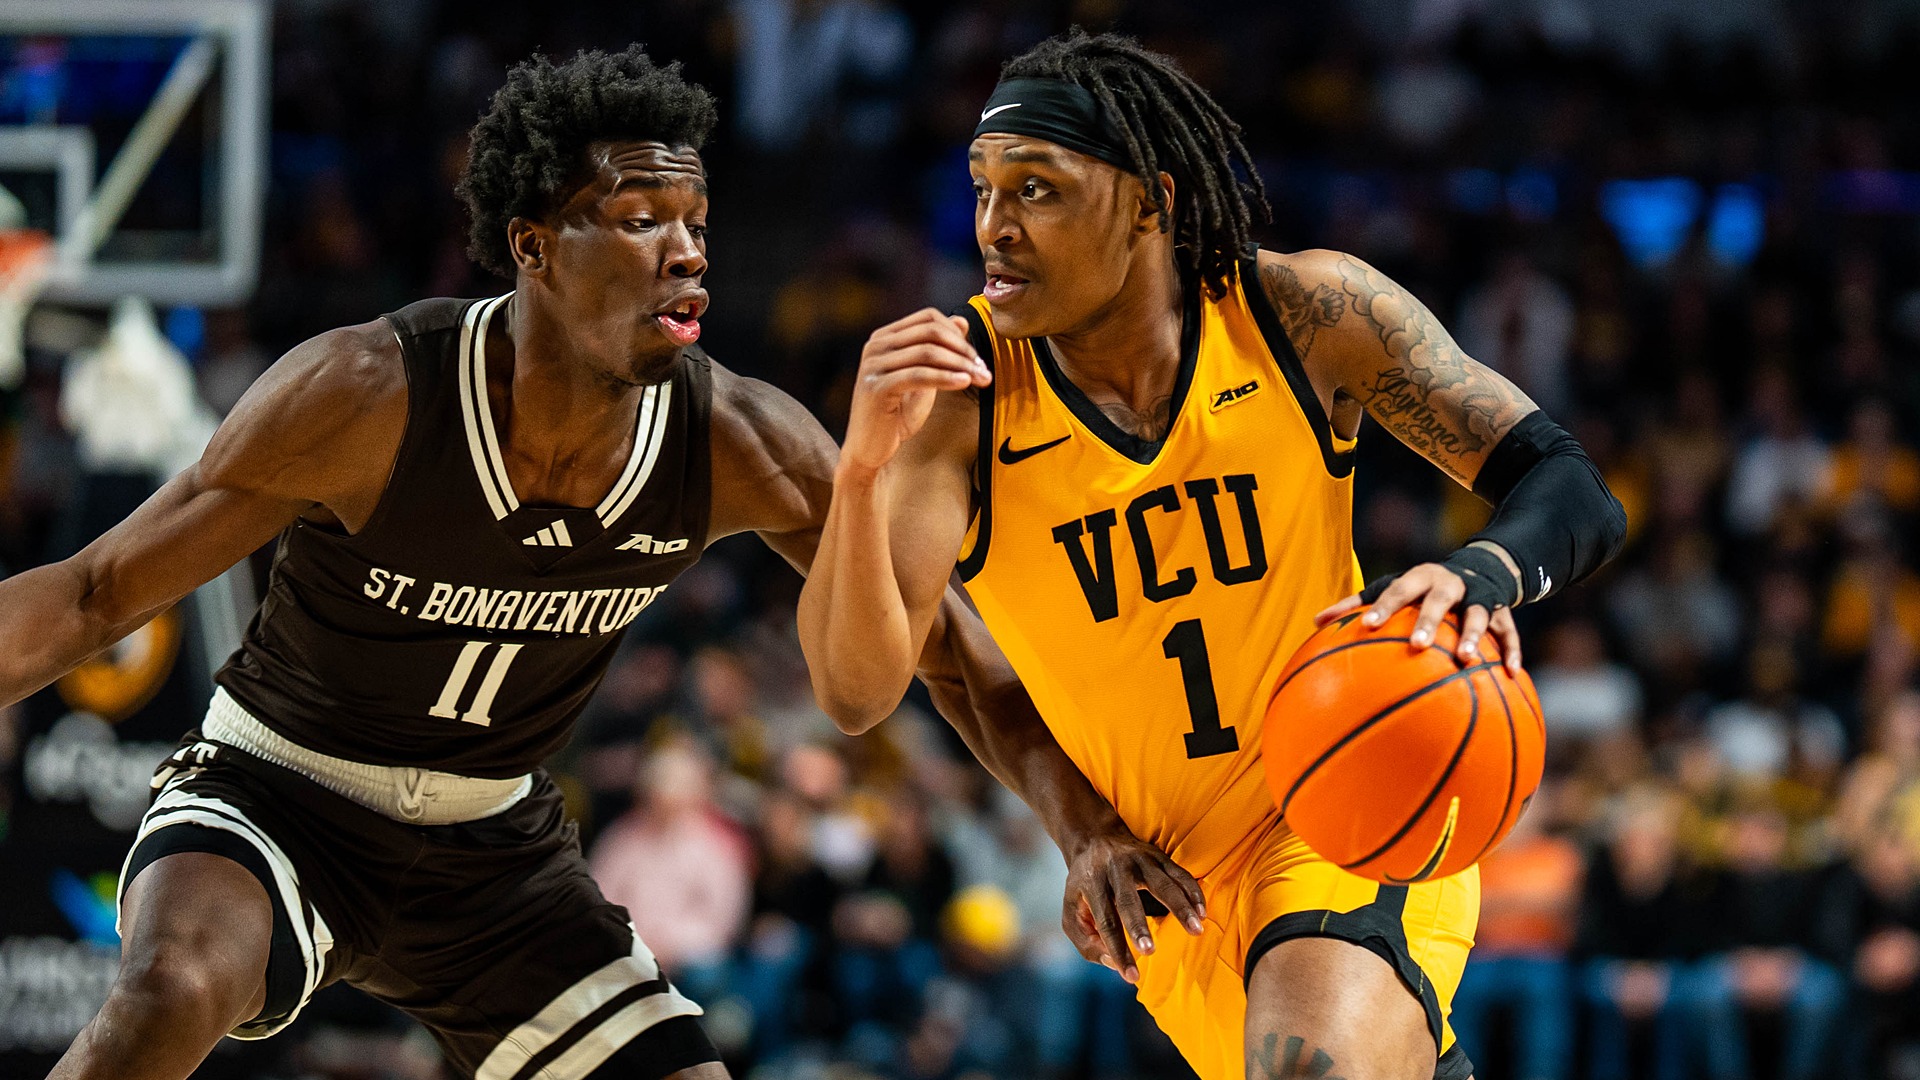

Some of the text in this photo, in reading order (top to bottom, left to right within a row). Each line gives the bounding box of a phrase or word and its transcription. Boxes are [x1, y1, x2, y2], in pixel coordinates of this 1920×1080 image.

[1213, 381, 1259, 408] A10
[615, 533, 689, 555] A10
[1051, 473, 1269, 623] VCU
[363, 567, 416, 615] ST.
[428, 640, 525, 727] 11
[1162, 618, 1240, 760] 1
